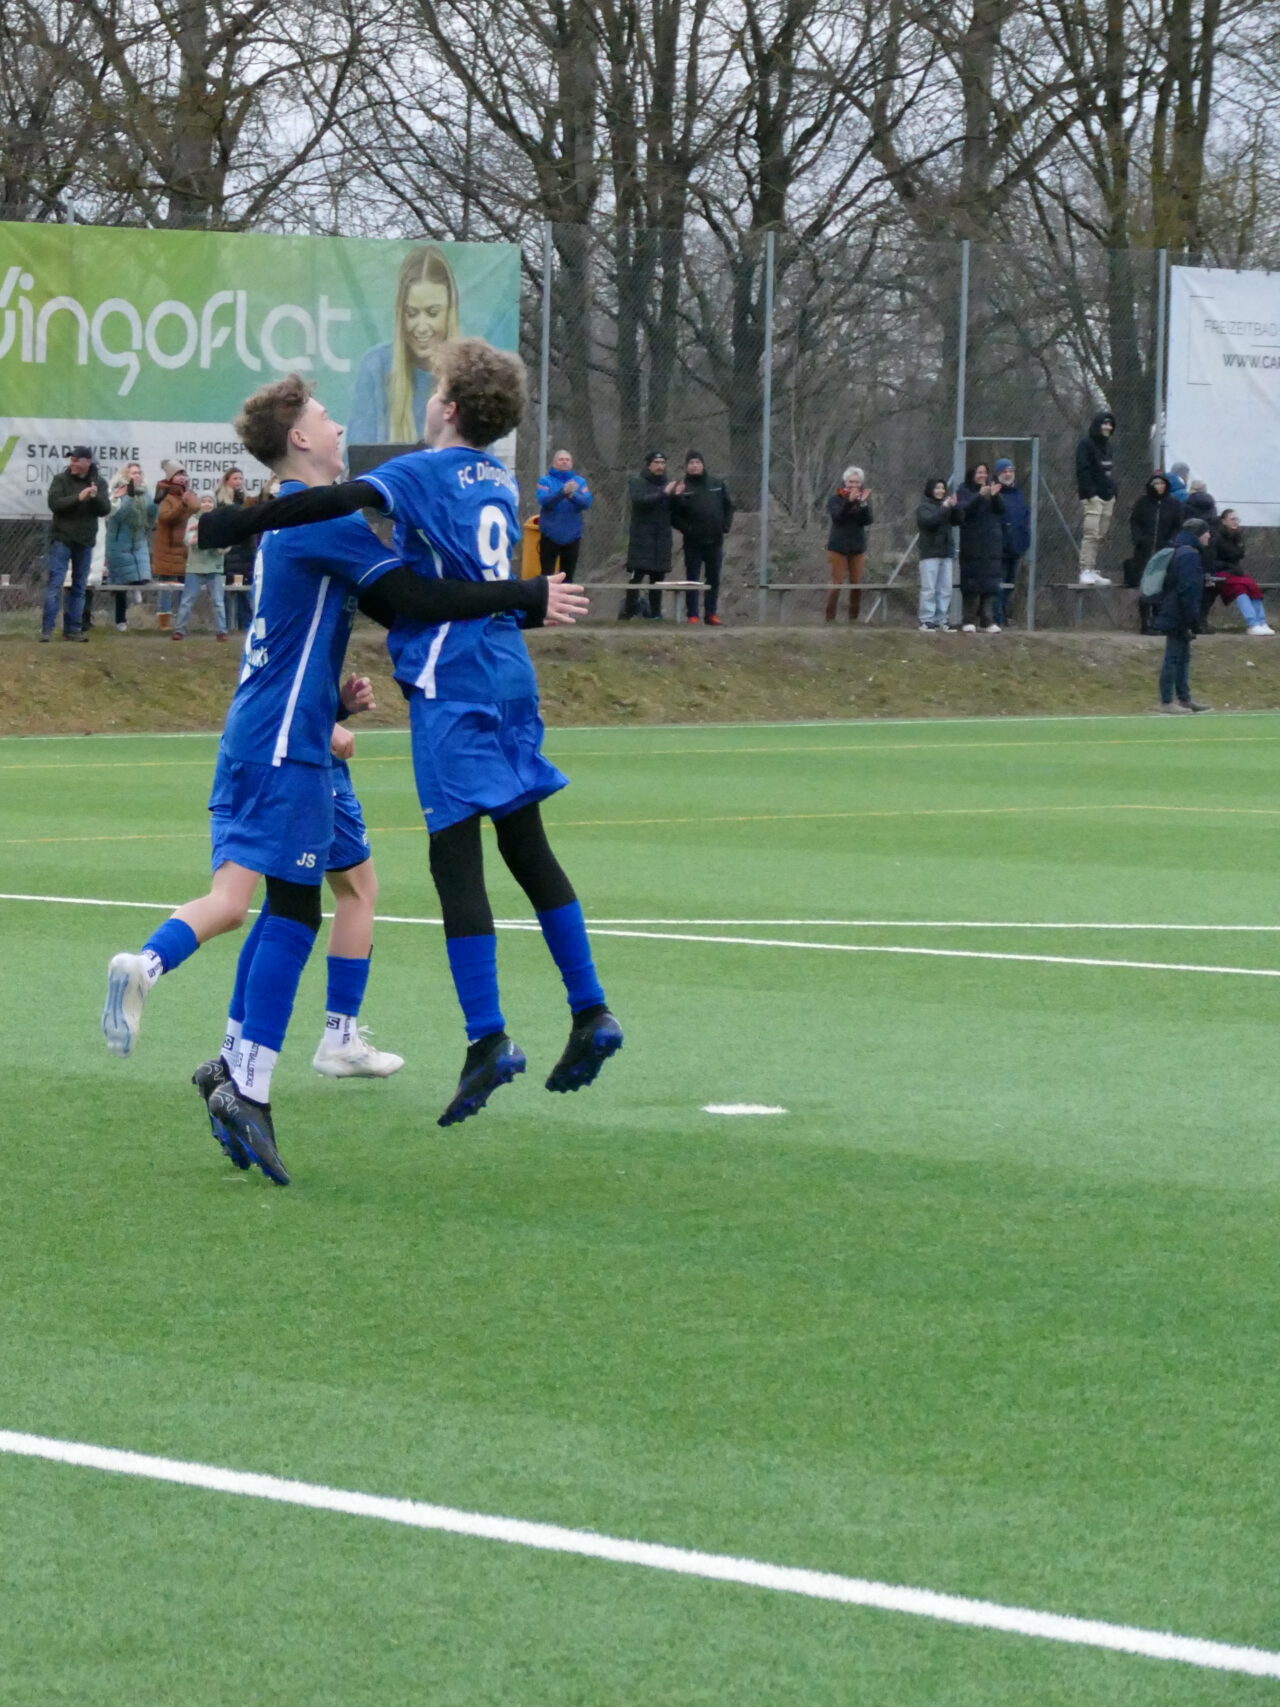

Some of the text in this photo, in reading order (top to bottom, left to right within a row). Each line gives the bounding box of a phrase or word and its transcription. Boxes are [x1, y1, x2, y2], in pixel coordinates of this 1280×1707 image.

[175, 441, 197, 454] IHR
[457, 465, 474, 489] FC
[478, 505, 510, 582] 9
[296, 852, 317, 868] JS
